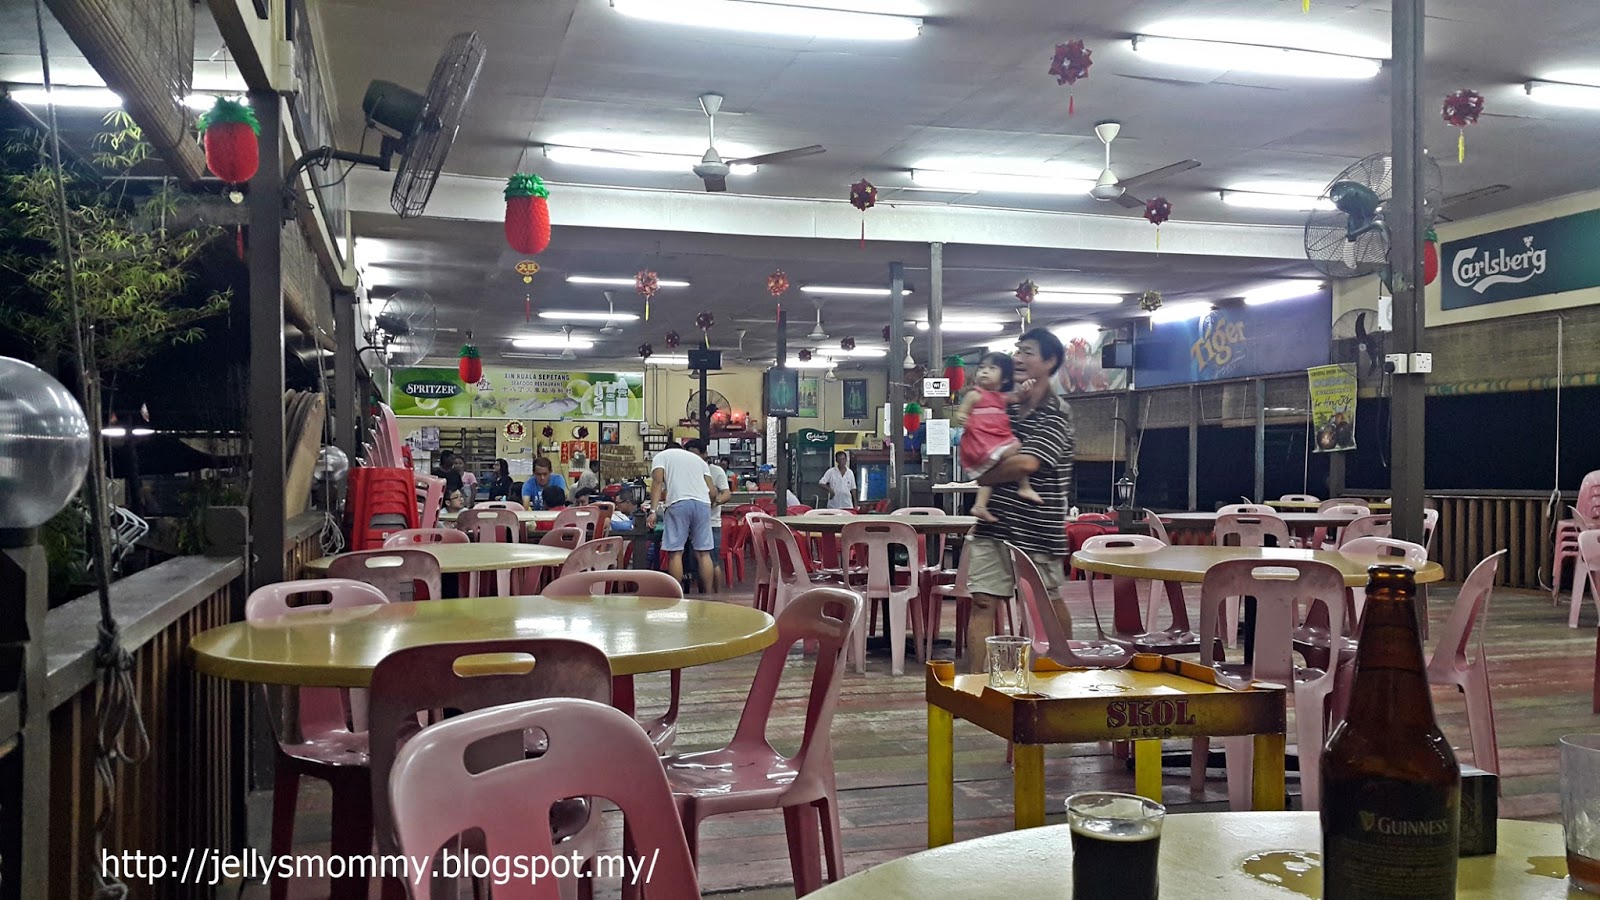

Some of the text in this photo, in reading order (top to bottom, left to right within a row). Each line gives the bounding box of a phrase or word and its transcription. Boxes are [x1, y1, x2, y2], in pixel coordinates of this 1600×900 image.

[1452, 246, 1547, 287] Carlsberg
[1190, 317, 1246, 371] Tiger
[1106, 699, 1196, 729] SKOL
[1131, 727, 1172, 737] BEER
[1377, 816, 1449, 836] GUINNESS
